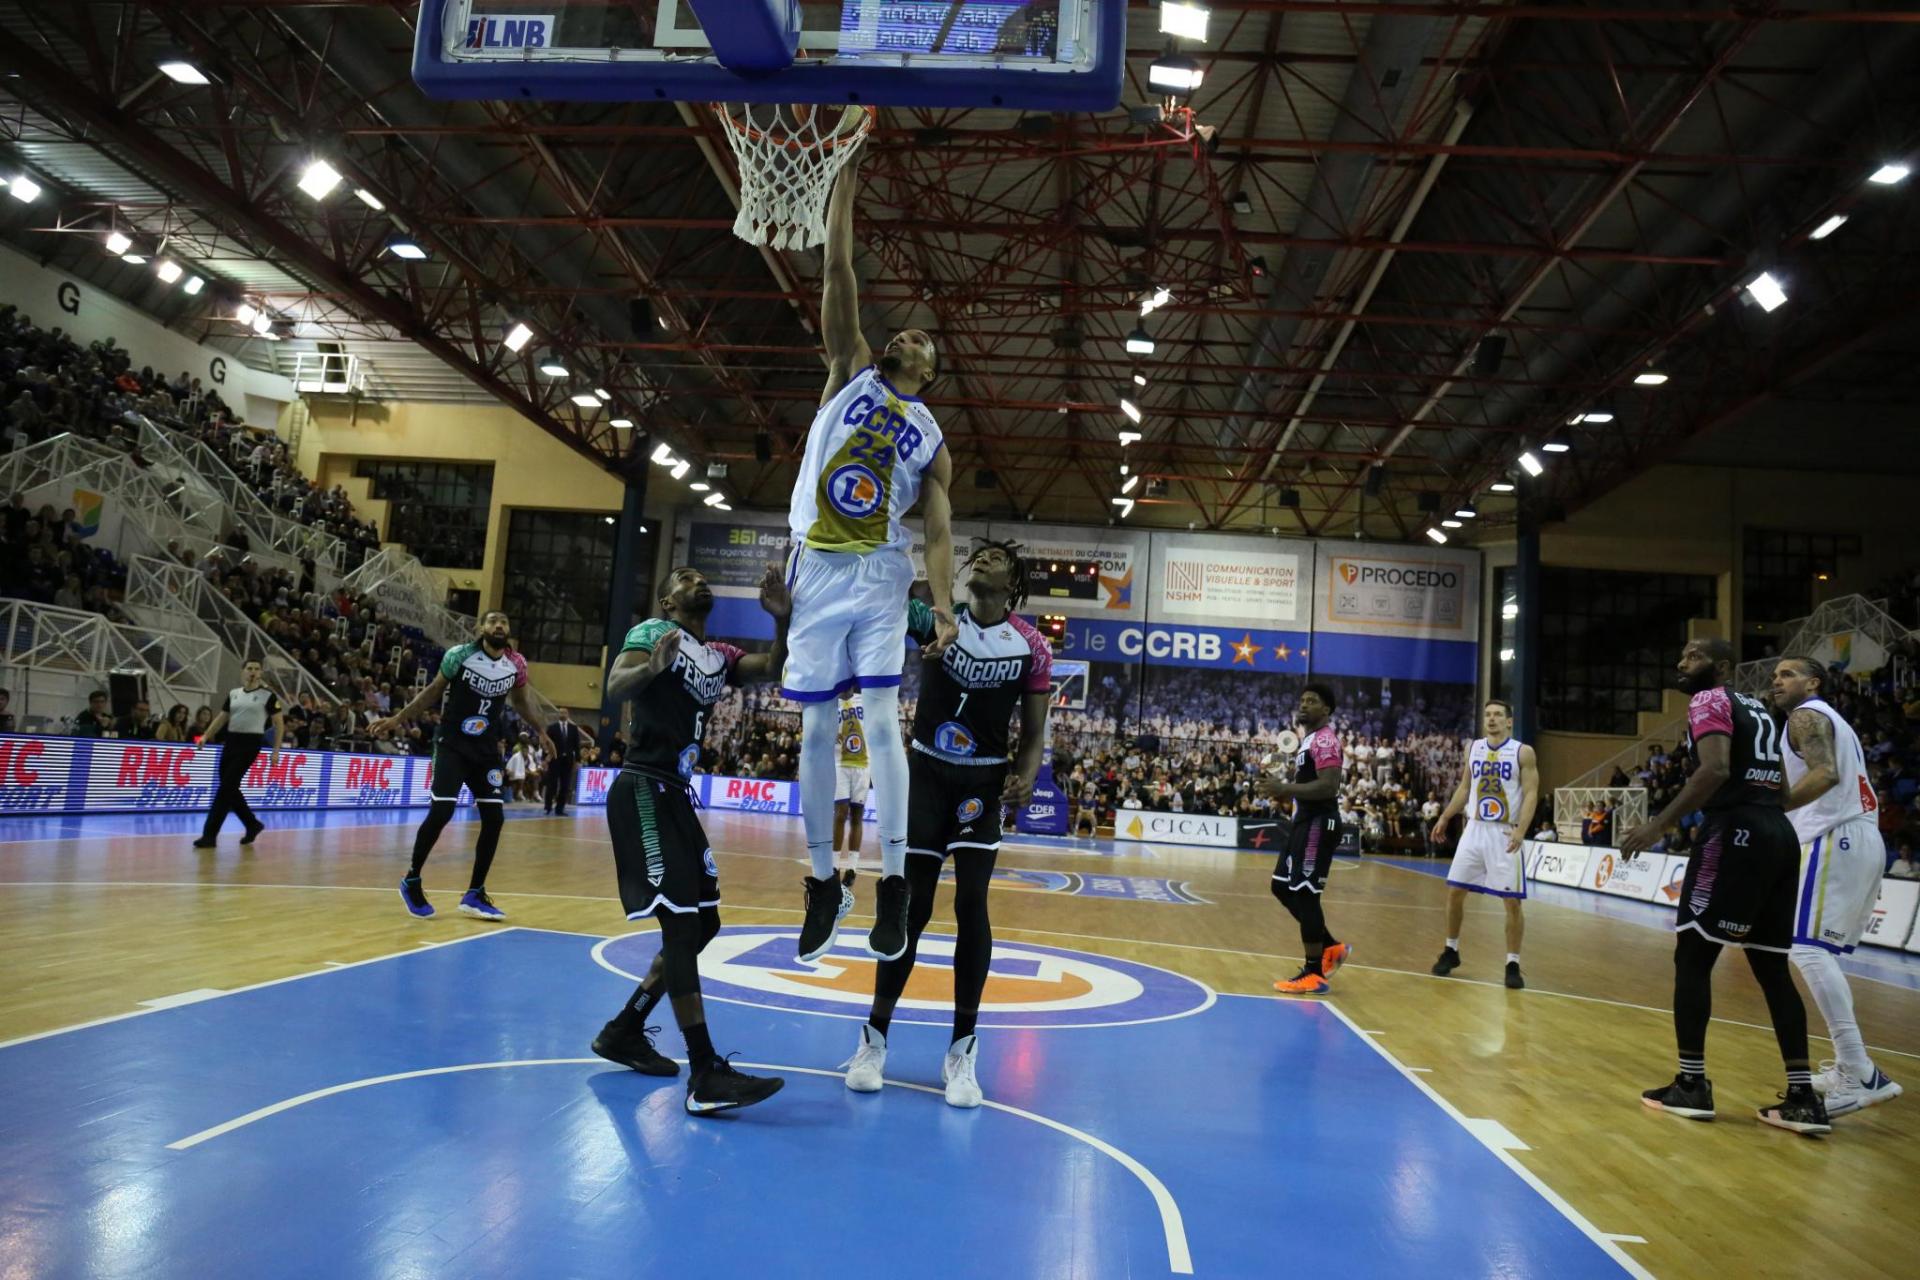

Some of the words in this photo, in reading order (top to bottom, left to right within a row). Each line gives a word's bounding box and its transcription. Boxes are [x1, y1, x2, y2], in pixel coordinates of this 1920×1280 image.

[57, 281, 81, 317] G
[209, 356, 227, 386] G
[843, 393, 923, 462] CCRB
[849, 431, 898, 468] 24
[728, 528, 757, 546] 361
[758, 533, 791, 550] degr
[953, 545, 969, 557] SAS
[1086, 550, 1112, 559] CCRB
[1112, 551, 1128, 559] SUR
[1205, 563, 1294, 577] COMMUNICATION
[1361, 566, 1457, 589] PROCEDO
[1205, 575, 1252, 586] VISUELLE
[1253, 578, 1262, 587] &
[1263, 577, 1296, 589] SPORT
[1165, 590, 1203, 603] NSHM
[1084, 627, 1107, 652] le
[1117, 627, 1222, 661] CCRB
[943, 643, 1023, 682] ERIGORD
[462, 668, 516, 694] PERIGORD
[477, 698, 493, 716] 12
[954, 692, 969, 717] 7
[693, 711, 704, 740] 6
[1748, 709, 1780, 762] 22
[116, 745, 196, 788] RMC
[247, 752, 307, 788] RMC
[345, 757, 393, 788] RMC
[1472, 759, 1513, 780] CCRB
[586, 770, 609, 792] RMC
[726, 779, 776, 801] RMC
[1480, 778, 1502, 794] 23
[135, 781, 209, 808] SPORT
[263, 782, 318, 807] SPORT
[358, 783, 401, 805] SPORT
[740, 795, 787, 813] SPORT
[1032, 788, 1054, 799] Jeep
[1028, 804, 1056, 816] CDER
[1150, 817, 1227, 839] CICAL
[1733, 828, 1751, 848] 22
[1838, 836, 1850, 851] 6
[1542, 854, 1567, 873] FCN
[1717, 919, 1751, 933] amaz
